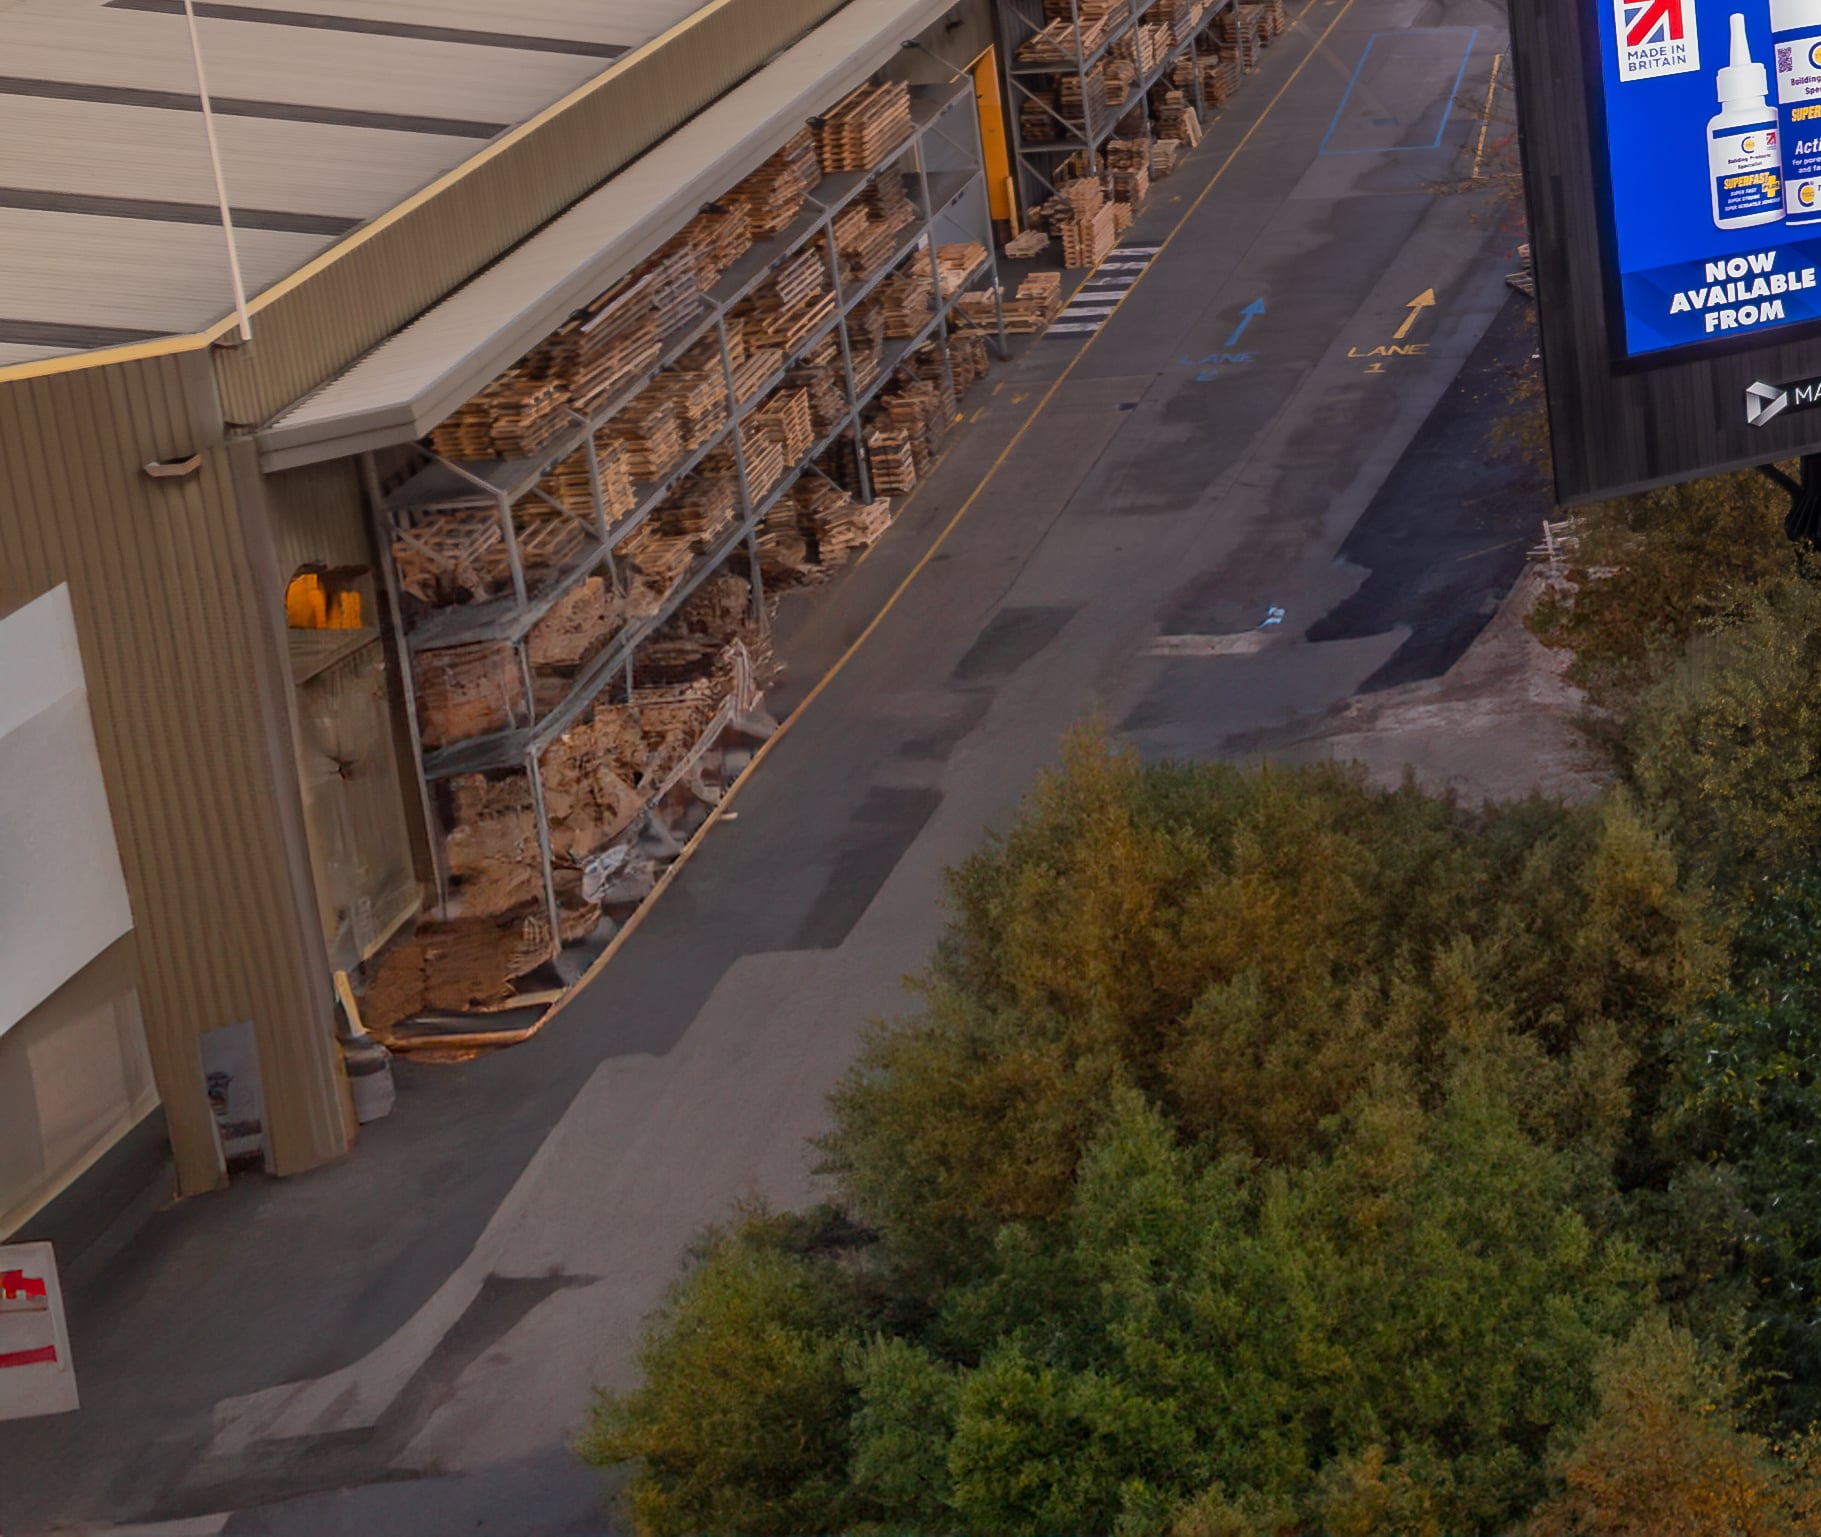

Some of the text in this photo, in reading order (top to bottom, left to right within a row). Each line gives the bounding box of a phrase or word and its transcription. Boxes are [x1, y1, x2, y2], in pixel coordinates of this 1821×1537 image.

[1627, 44, 1685, 61] MADE IN
[1628, 55, 1687, 72] BRITAIN
[1790, 74, 1821, 86] Building
[1723, 172, 1770, 190] SUPERFAST
[1705, 250, 1777, 284] NOW
[1670, 267, 1817, 315] AVAILABLE
[1705, 299, 1785, 333] FROM
[1179, 351, 1261, 365] LANE
[1347, 344, 1431, 358] LANE
[1363, 362, 1386, 373] 1
